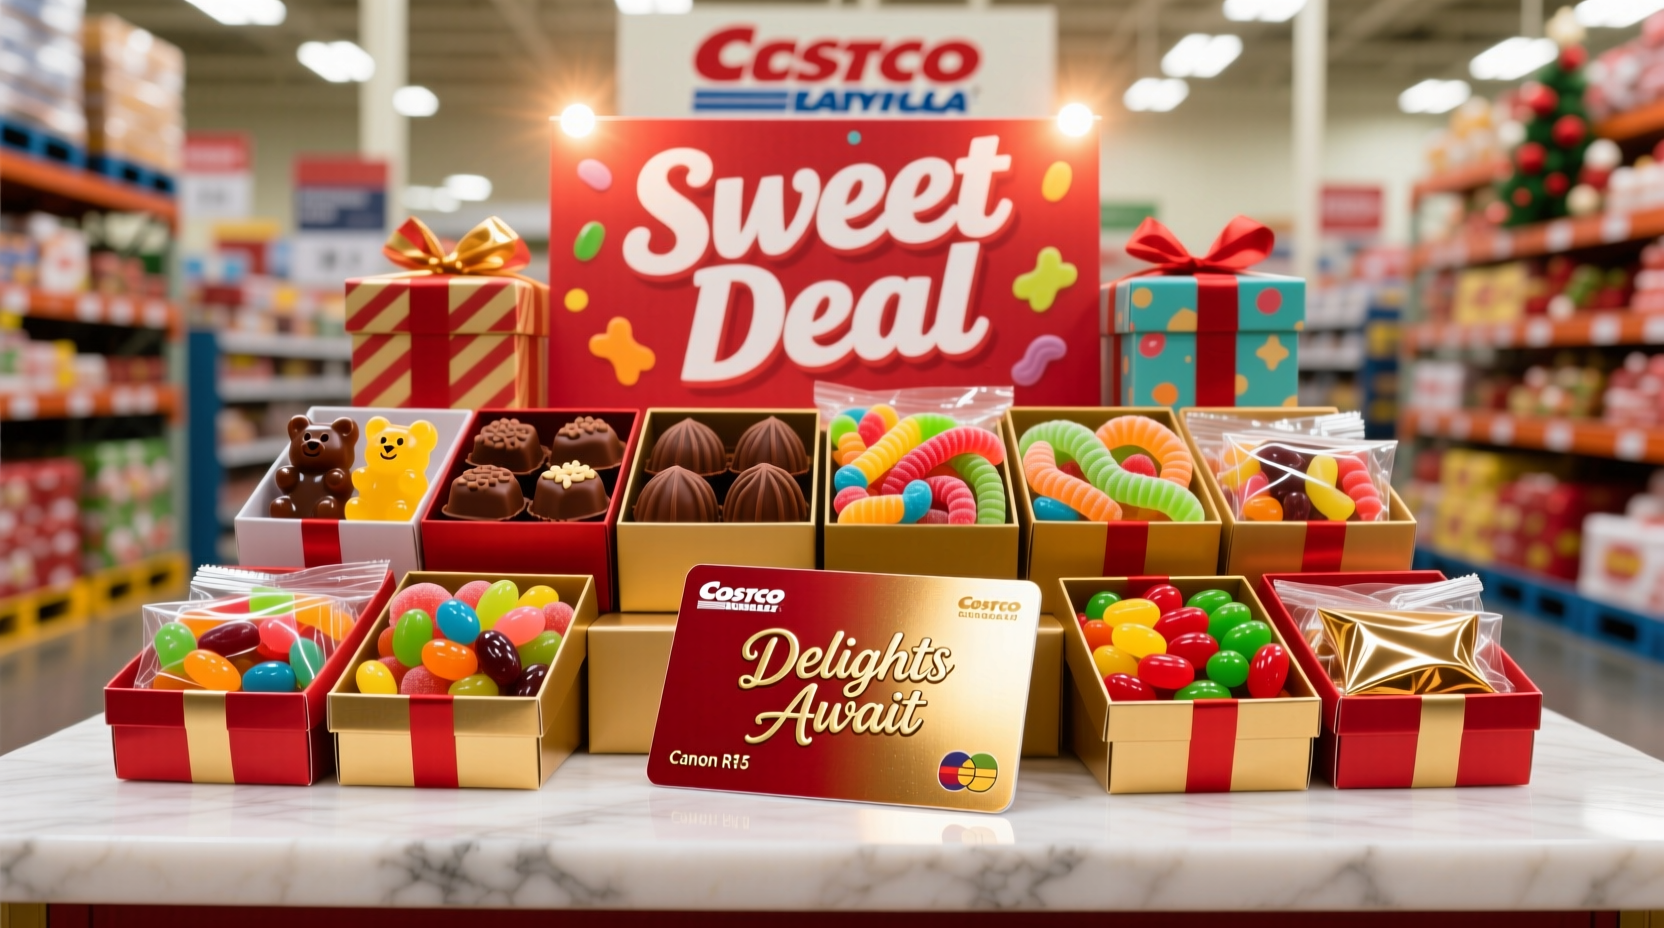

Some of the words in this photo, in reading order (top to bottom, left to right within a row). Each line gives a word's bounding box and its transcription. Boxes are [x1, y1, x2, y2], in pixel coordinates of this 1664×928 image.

[622, 135, 1013, 276] Sweet
[680, 241, 990, 382] Deal
[738, 628, 955, 698] Delights
[744, 683, 928, 746] Await
[669, 749, 718, 768] Canon
